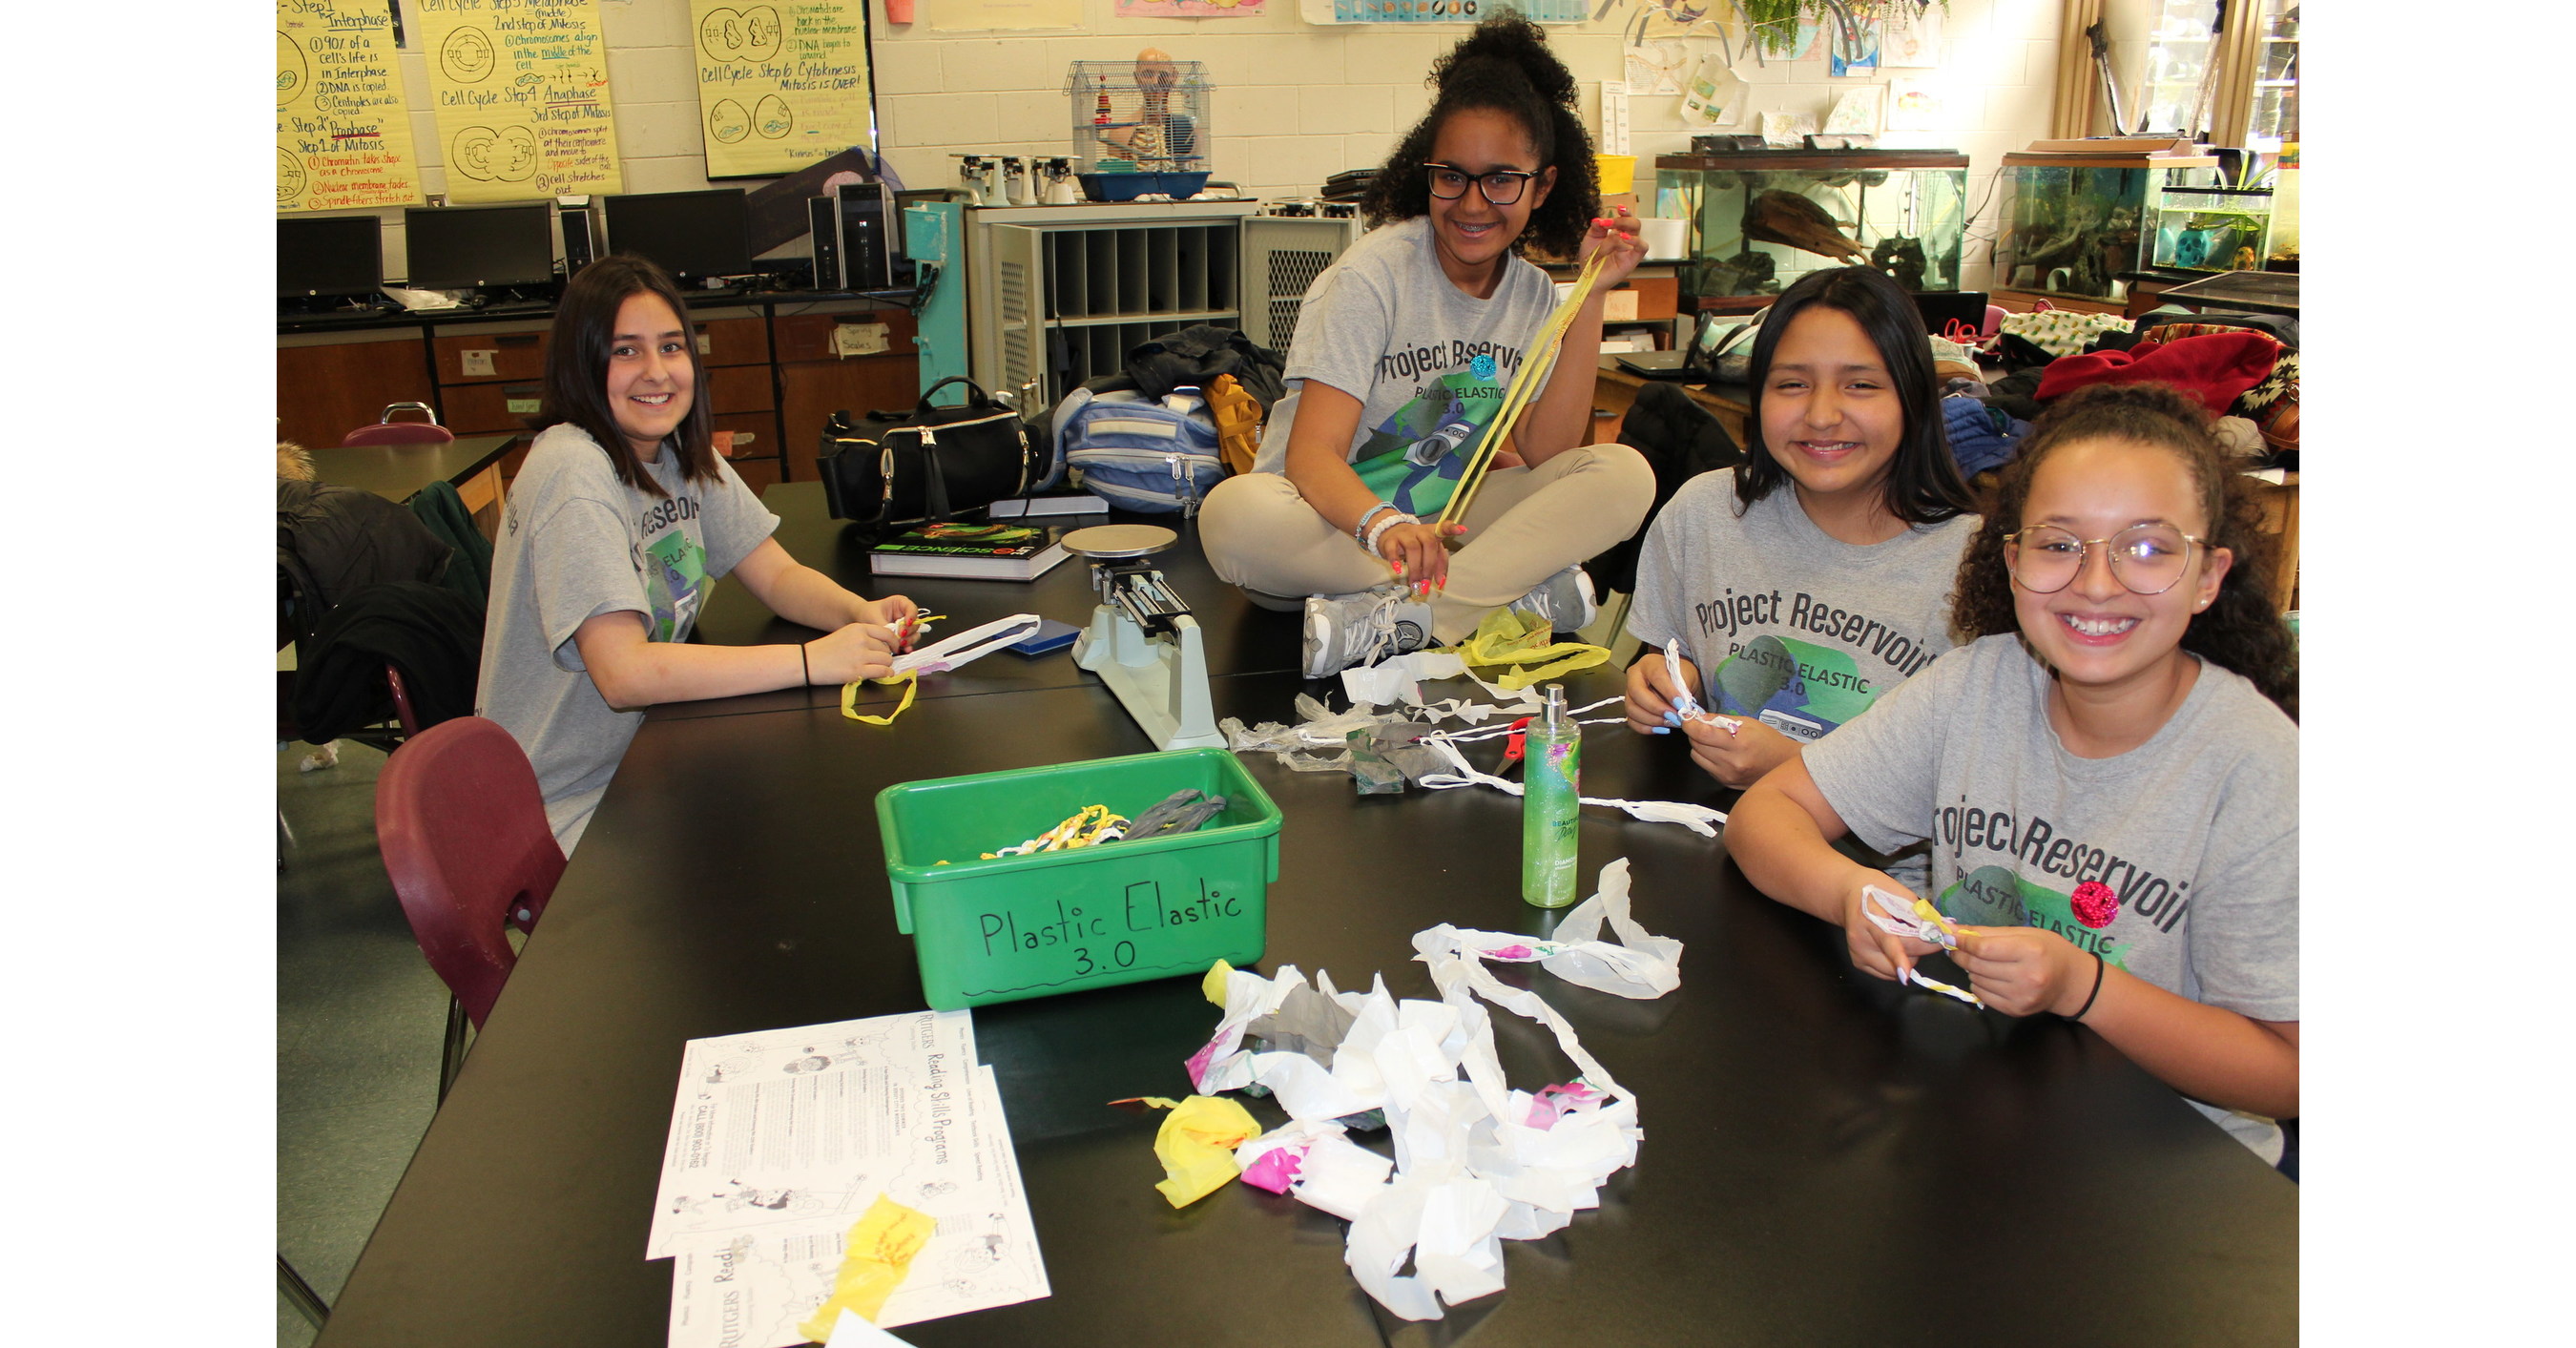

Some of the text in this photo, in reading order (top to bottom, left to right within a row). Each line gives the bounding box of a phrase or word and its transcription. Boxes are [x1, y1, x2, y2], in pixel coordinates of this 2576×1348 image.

[549, 18, 586, 31] Mitosis
[574, 31, 598, 47] align
[799, 39, 820, 51] DNA
[724, 64, 753, 86] Cycle
[758, 64, 782, 83] Step
[798, 61, 856, 80] Cytokinesis
[328, 82, 350, 93] DNA
[779, 79, 818, 91] Mitosis
[442, 91, 465, 106] Cell
[468, 91, 498, 111] Cycle
[505, 87, 529, 106] Step
[544, 85, 596, 105] Anaphase
[583, 104, 611, 118] Mitosis
[292, 116, 316, 137] Step
[298, 138, 319, 156] Step
[344, 138, 384, 152] Mitosis
[567, 171, 605, 183] stretches
[1695, 588, 1782, 639] Project
[1729, 642, 1871, 695] PLASTIC ELASTIC
[1933, 794, 2018, 859] roject
[980, 877, 1242, 956] Plastic Elastic
[1956, 865, 2115, 955] PLASTIC ELASTIC
[1074, 941, 1136, 975] 3.0
[914, 1014, 951, 1165] RUTGERS Reading Skills Programs
[695, 1105, 707, 1122] CALL
